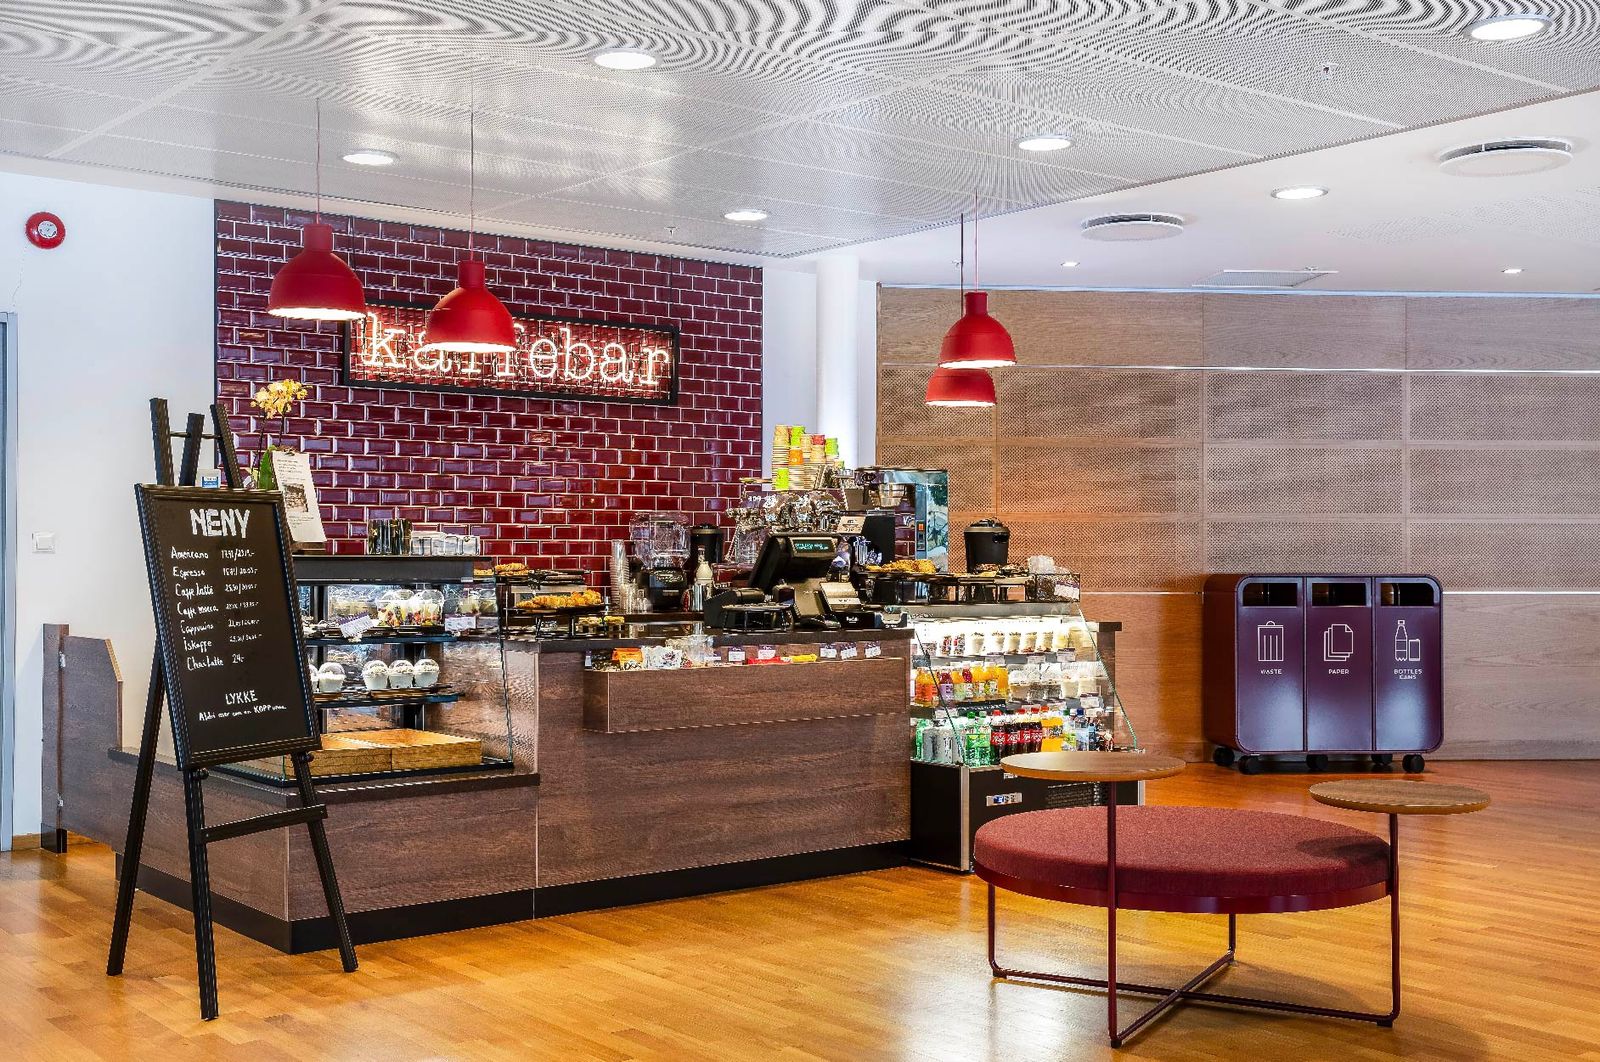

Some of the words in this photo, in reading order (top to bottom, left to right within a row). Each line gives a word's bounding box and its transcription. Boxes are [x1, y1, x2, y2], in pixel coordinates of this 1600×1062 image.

[171, 546, 209, 560] Americano
[172, 566, 206, 580] Espresso
[225, 689, 258, 705] LYKKE
[253, 704, 272, 714] KOPP
